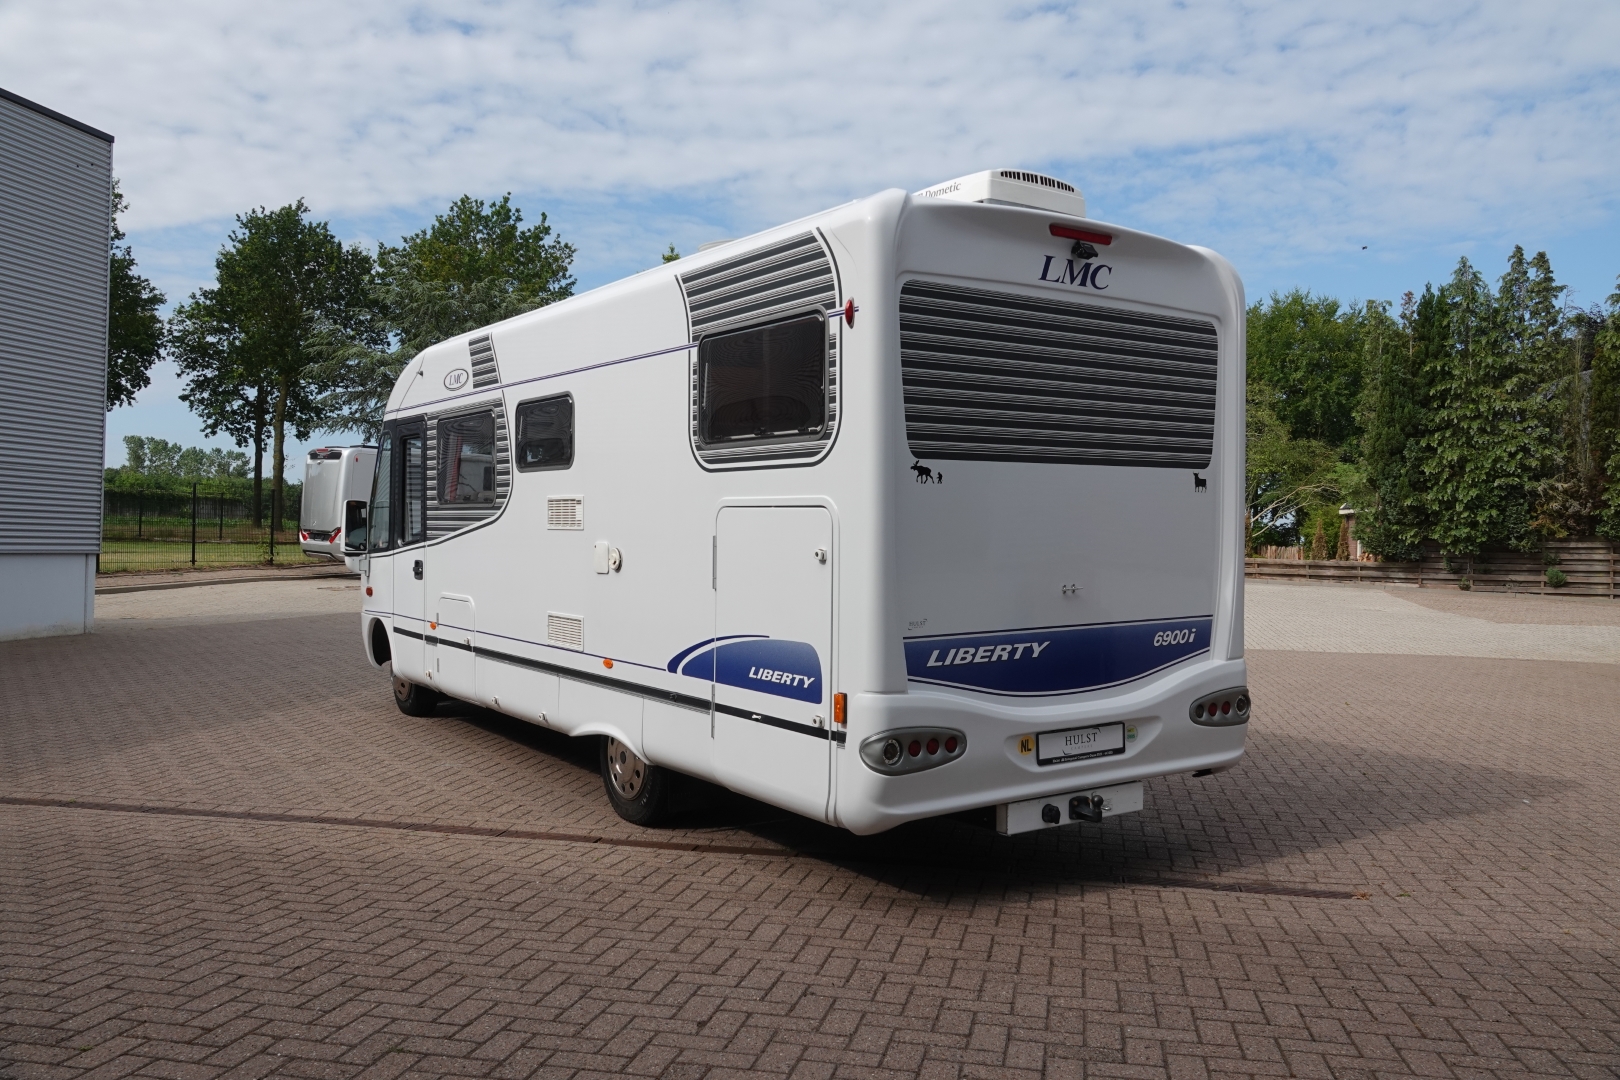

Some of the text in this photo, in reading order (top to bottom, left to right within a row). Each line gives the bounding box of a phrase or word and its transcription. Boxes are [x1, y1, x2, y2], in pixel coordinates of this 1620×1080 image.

[925, 182, 961, 198] Dometic
[1038, 254, 1113, 290] LMC
[448, 373, 464, 386] LMC
[926, 641, 1051, 667] LIBERTY
[748, 666, 815, 689] LIBERTY
[1020, 739, 1032, 753] NL
[1065, 732, 1098, 746] HULST
